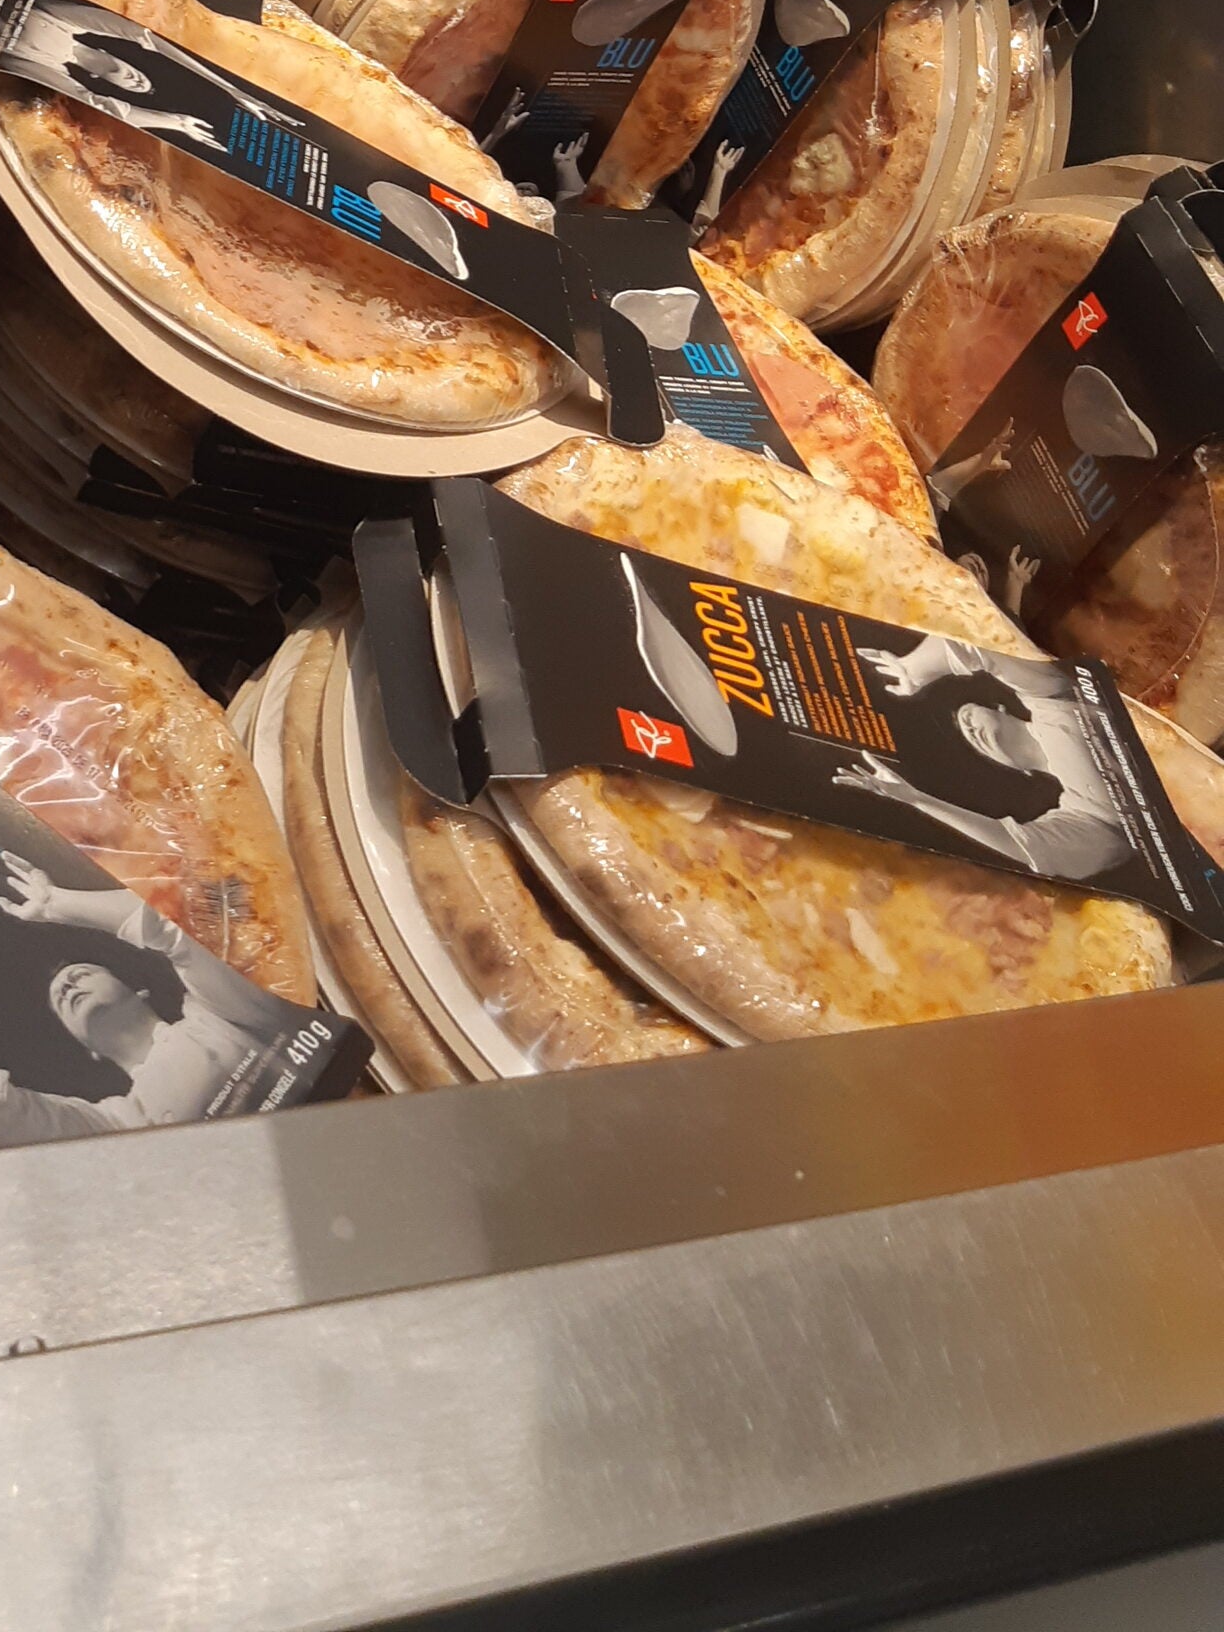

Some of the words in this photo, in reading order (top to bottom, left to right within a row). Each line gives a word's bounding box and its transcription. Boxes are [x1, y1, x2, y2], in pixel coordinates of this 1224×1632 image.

[597, 37, 656, 69] BLU
[776, 45, 815, 101] BLU
[332, 184, 382, 239] BLU
[681, 342, 740, 378] BLU
[1067, 452, 1117, 523] BLU
[691, 582, 775, 718] ZUCCA
[1073, 666, 1091, 675] g
[1079, 681, 1100, 702] 400
[282, 1027, 322, 1069] 410
[307, 1018, 333, 1042] g
[204, 1079, 235, 1115] PRODUIT
